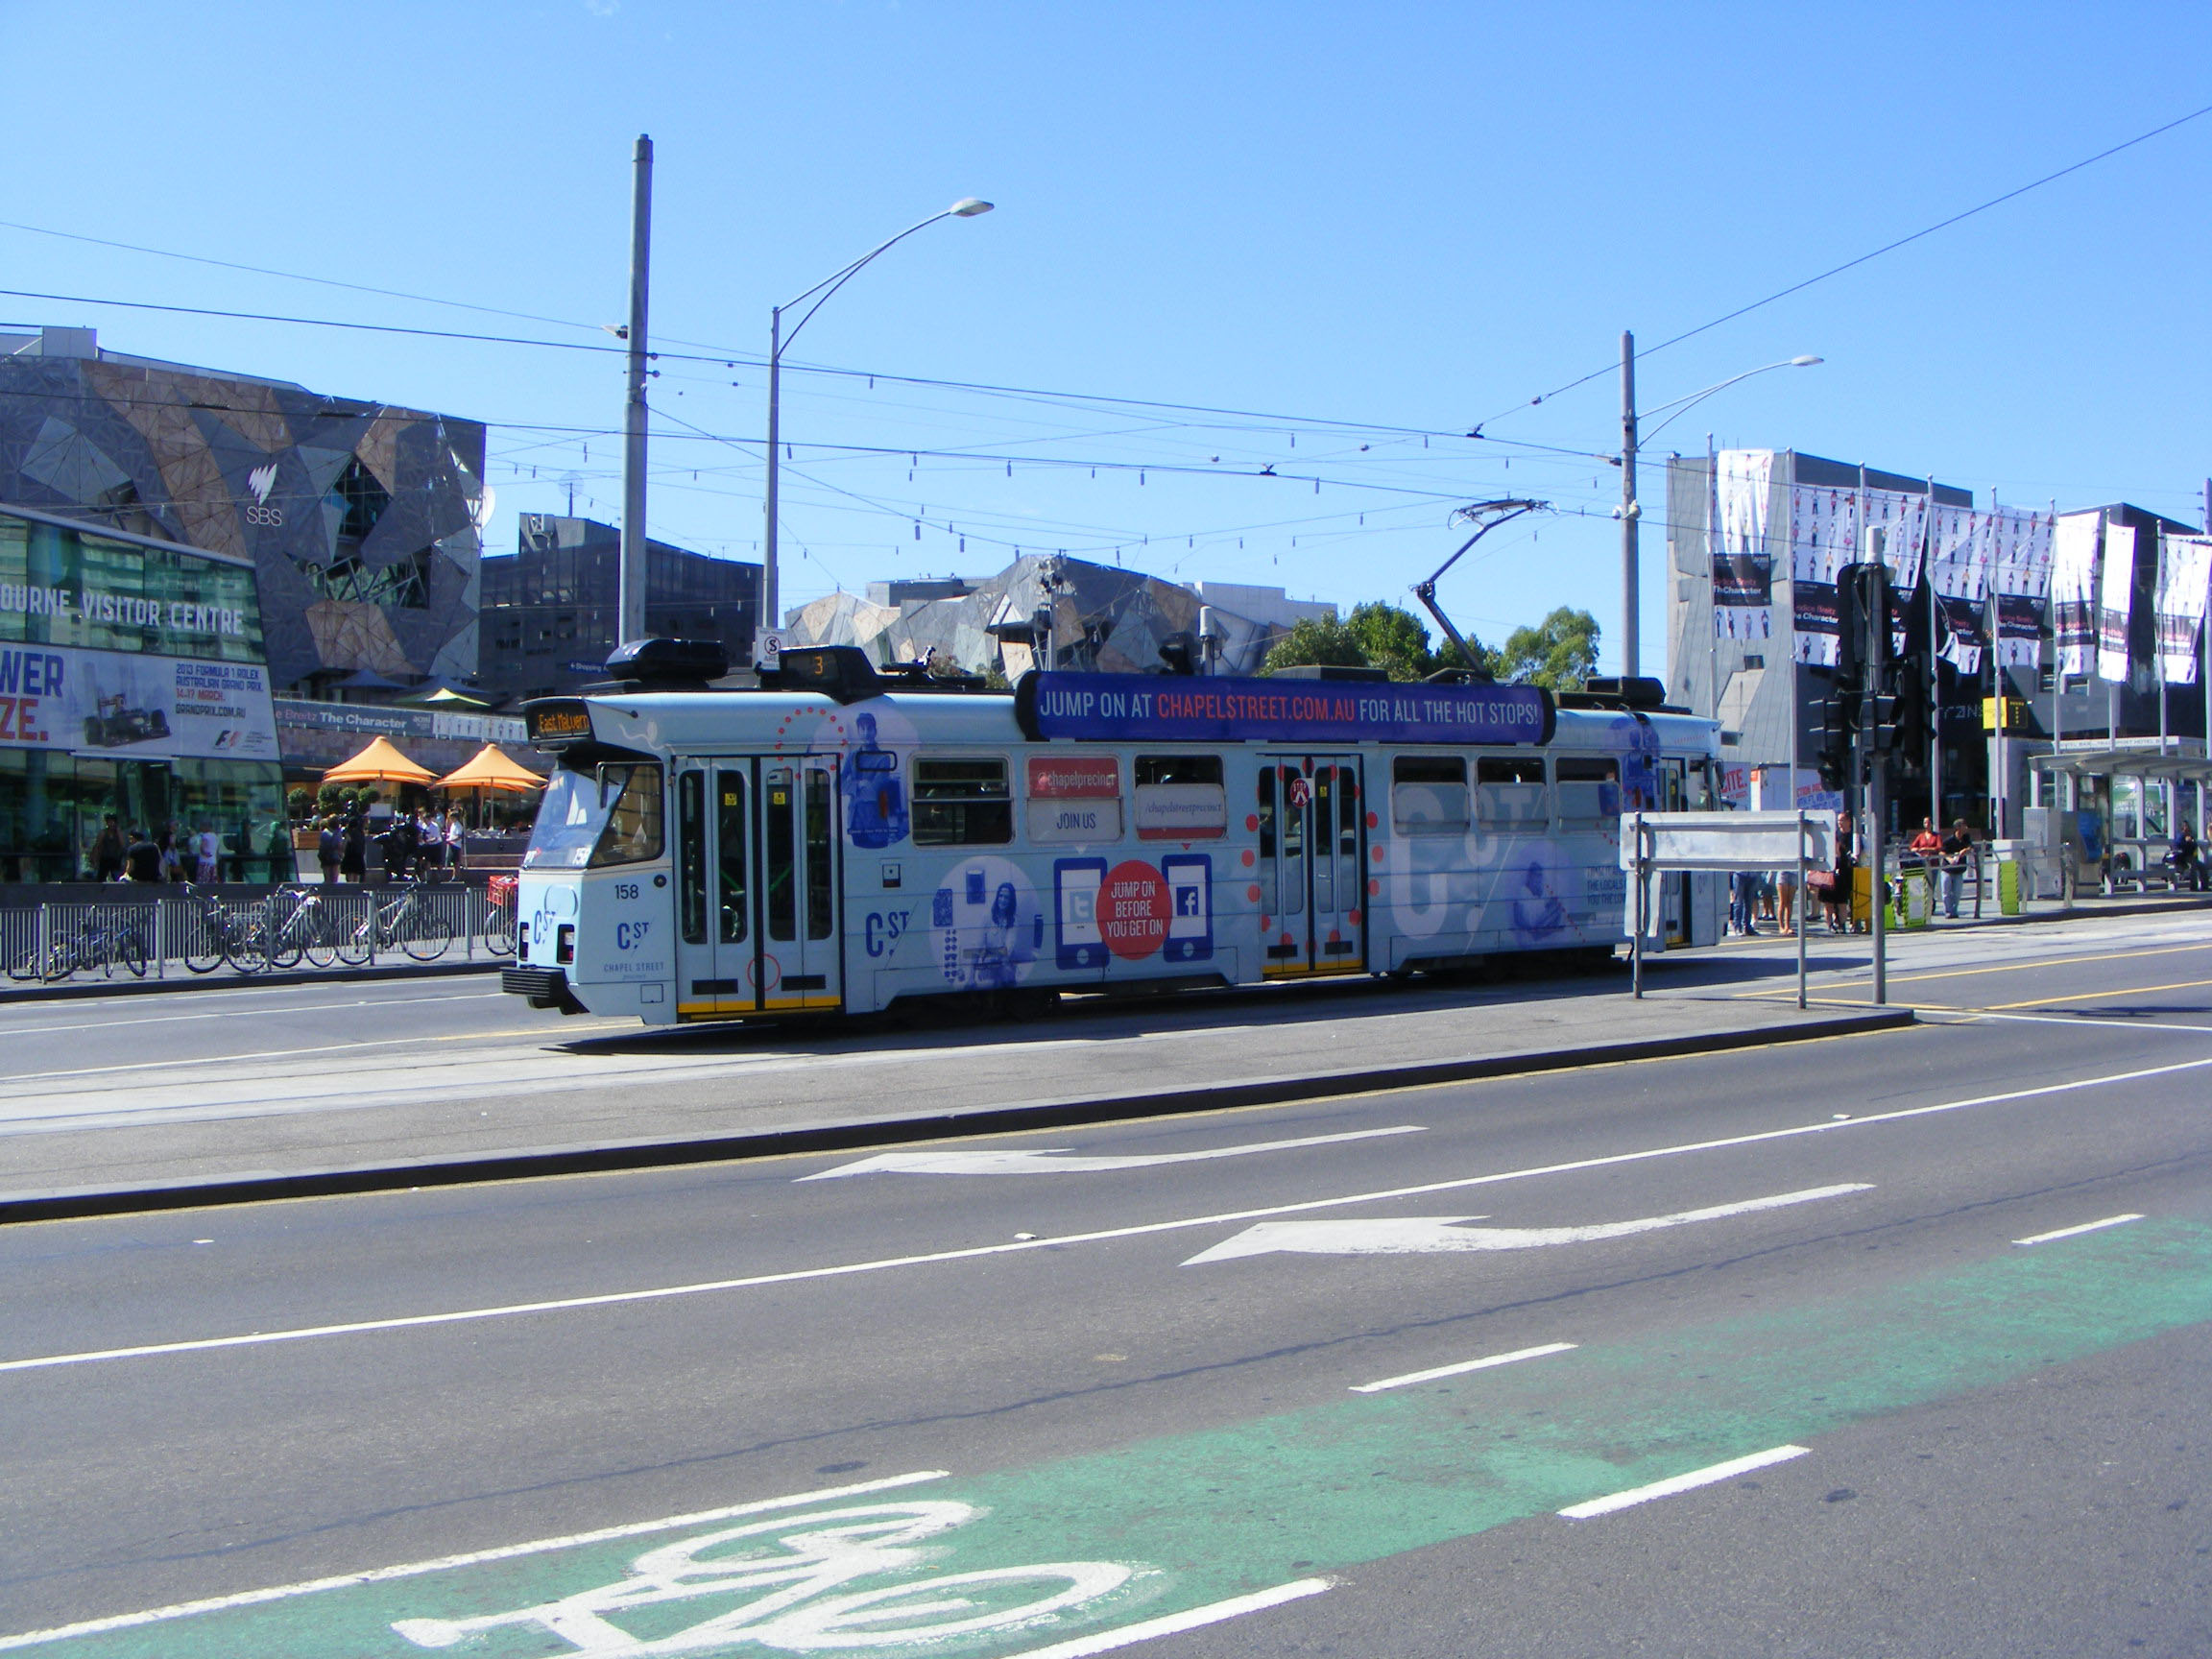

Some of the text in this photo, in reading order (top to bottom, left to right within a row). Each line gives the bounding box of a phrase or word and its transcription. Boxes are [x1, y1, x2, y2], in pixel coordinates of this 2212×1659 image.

[247, 506, 282, 527] SBS
[83, 593, 160, 626] VISITOR
[170, 602, 245, 635] CENTRE
[177, 663, 194, 675] 2013
[196, 664, 229, 678] FORMULA
[237, 668, 259, 680] ROLEX
[814, 656, 823, 674] 3
[176, 675, 220, 689] AUSTRALIAN
[222, 679, 244, 690] GRAND
[176, 703, 247, 718] GRANDPRIX.COM.AU
[1040, 691, 1539, 726] JUMP ON AT CHAPELSTREET.COM.AU FOR ALL THE HOT STOPS!
[320, 712, 344, 724] The
[346, 713, 407, 729] Character
[539, 712, 589, 733] East Malvern
[1038, 770, 1117, 790] @chapelprecinct
[1145, 801, 1221, 815] /chapelstreetprecinct
[1057, 813, 1096, 830] JOIN US
[614, 884, 639, 900] 158
[1111, 880, 1156, 899] JUMP ON
[1116, 900, 1152, 918] BEFORE
[1107, 919, 1164, 938] YOU GET ON
[604, 961, 664, 974] CHAPEL STREET
